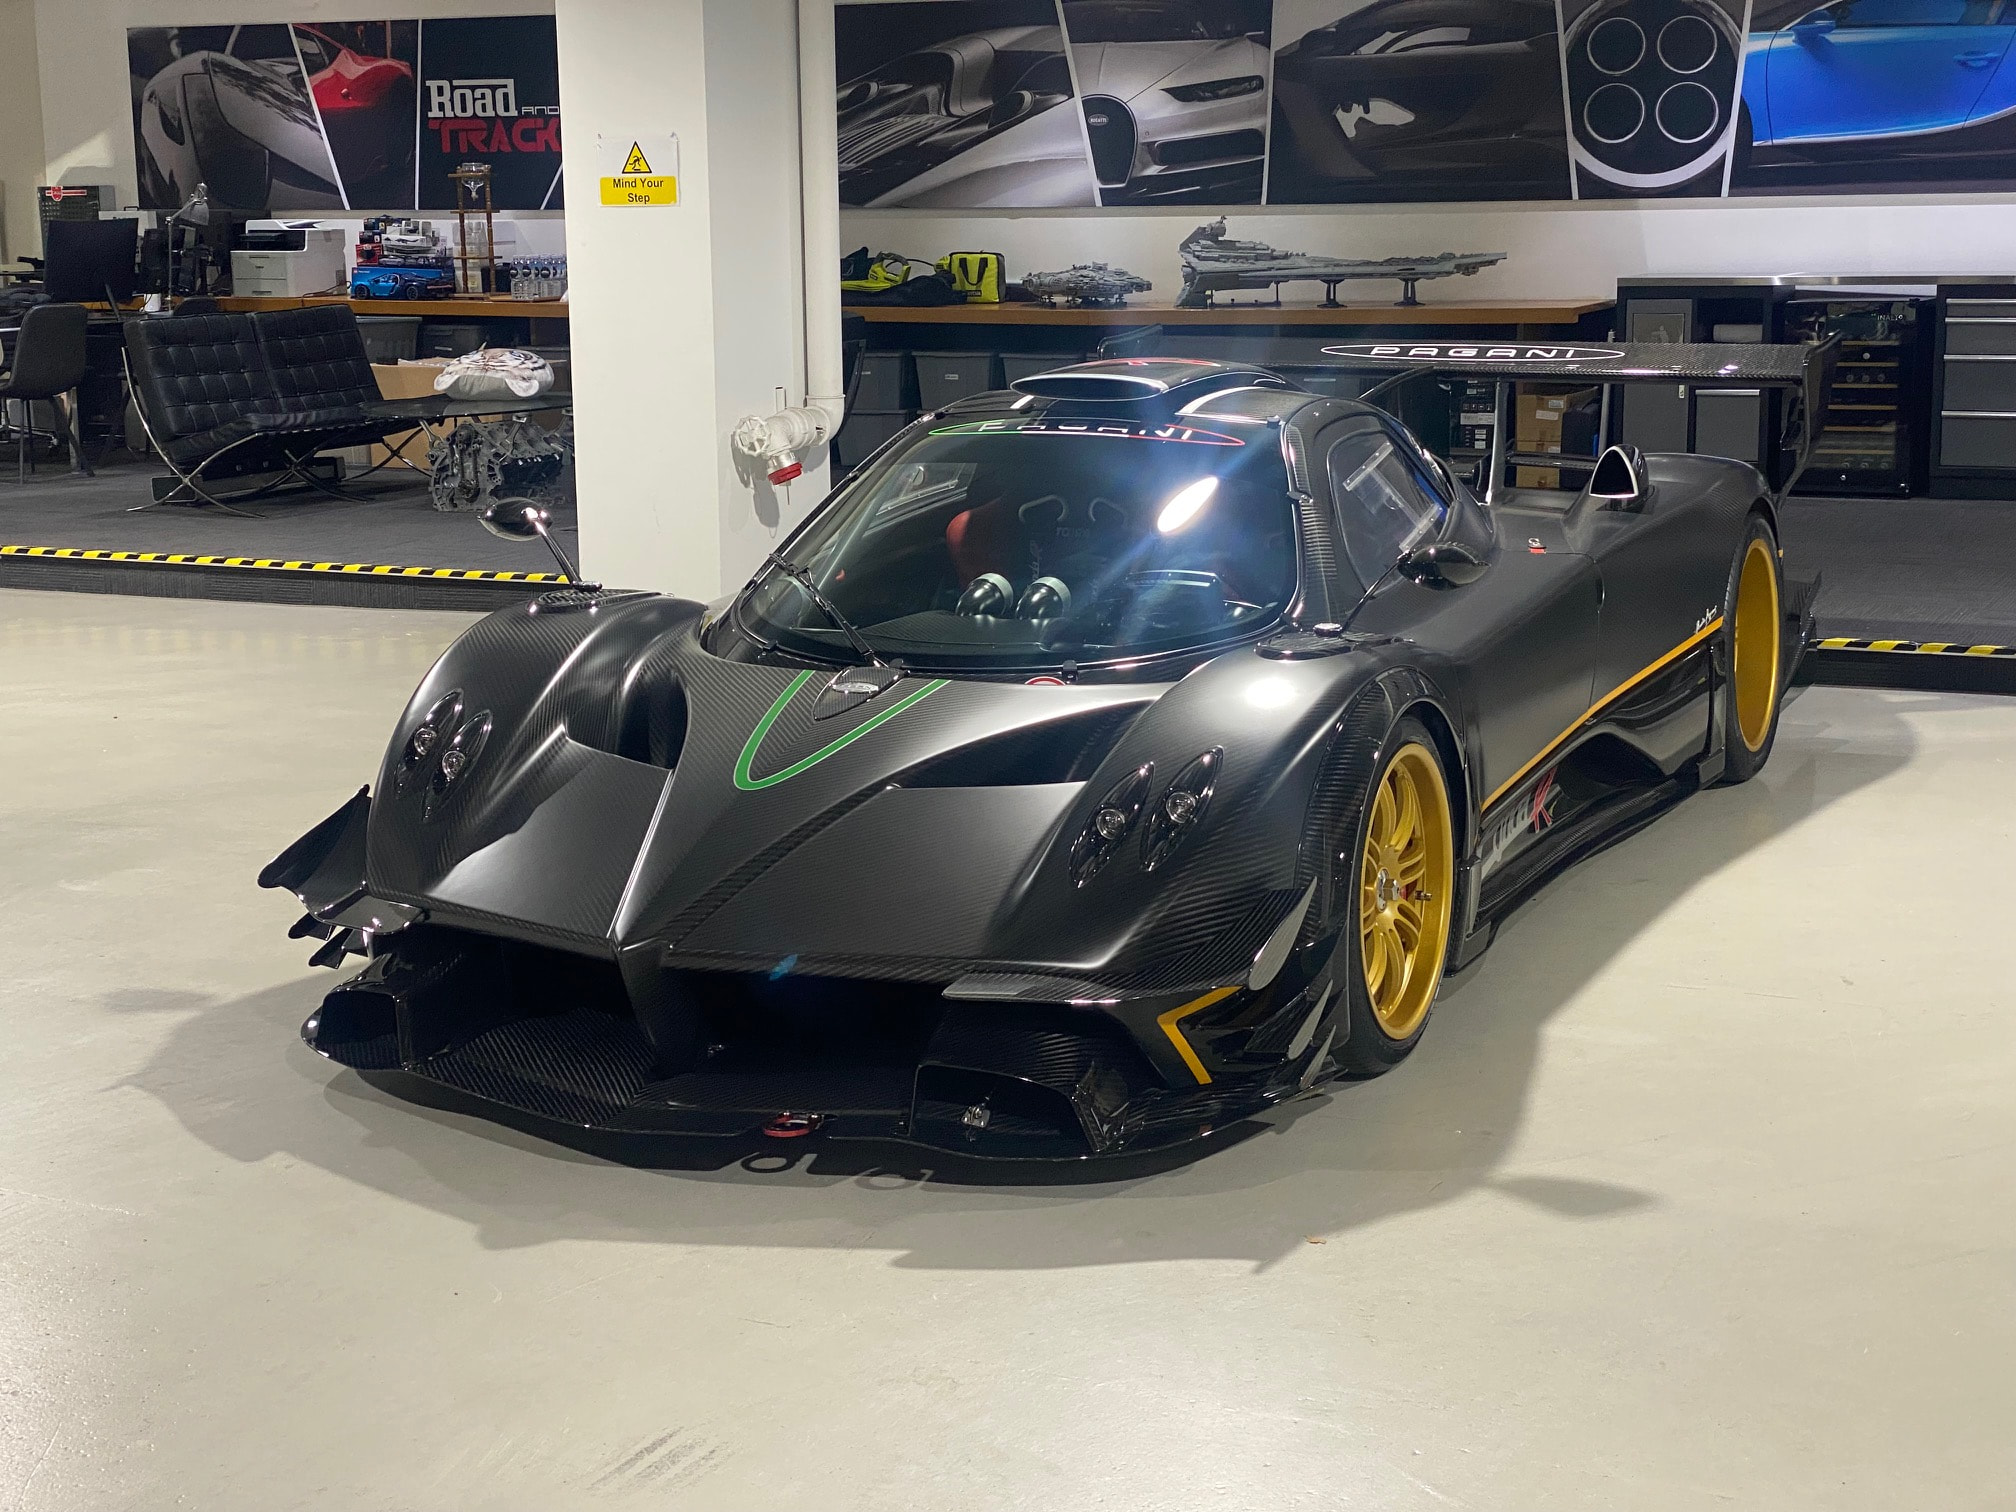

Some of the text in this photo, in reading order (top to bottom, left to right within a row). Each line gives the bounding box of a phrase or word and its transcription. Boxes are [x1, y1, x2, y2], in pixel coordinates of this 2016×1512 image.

[425, 78, 559, 118] Road AND
[427, 117, 562, 153] TRACK
[612, 178, 664, 188] Mind Your
[627, 192, 651, 204] Step
[1370, 346, 1575, 358] PAGANI
